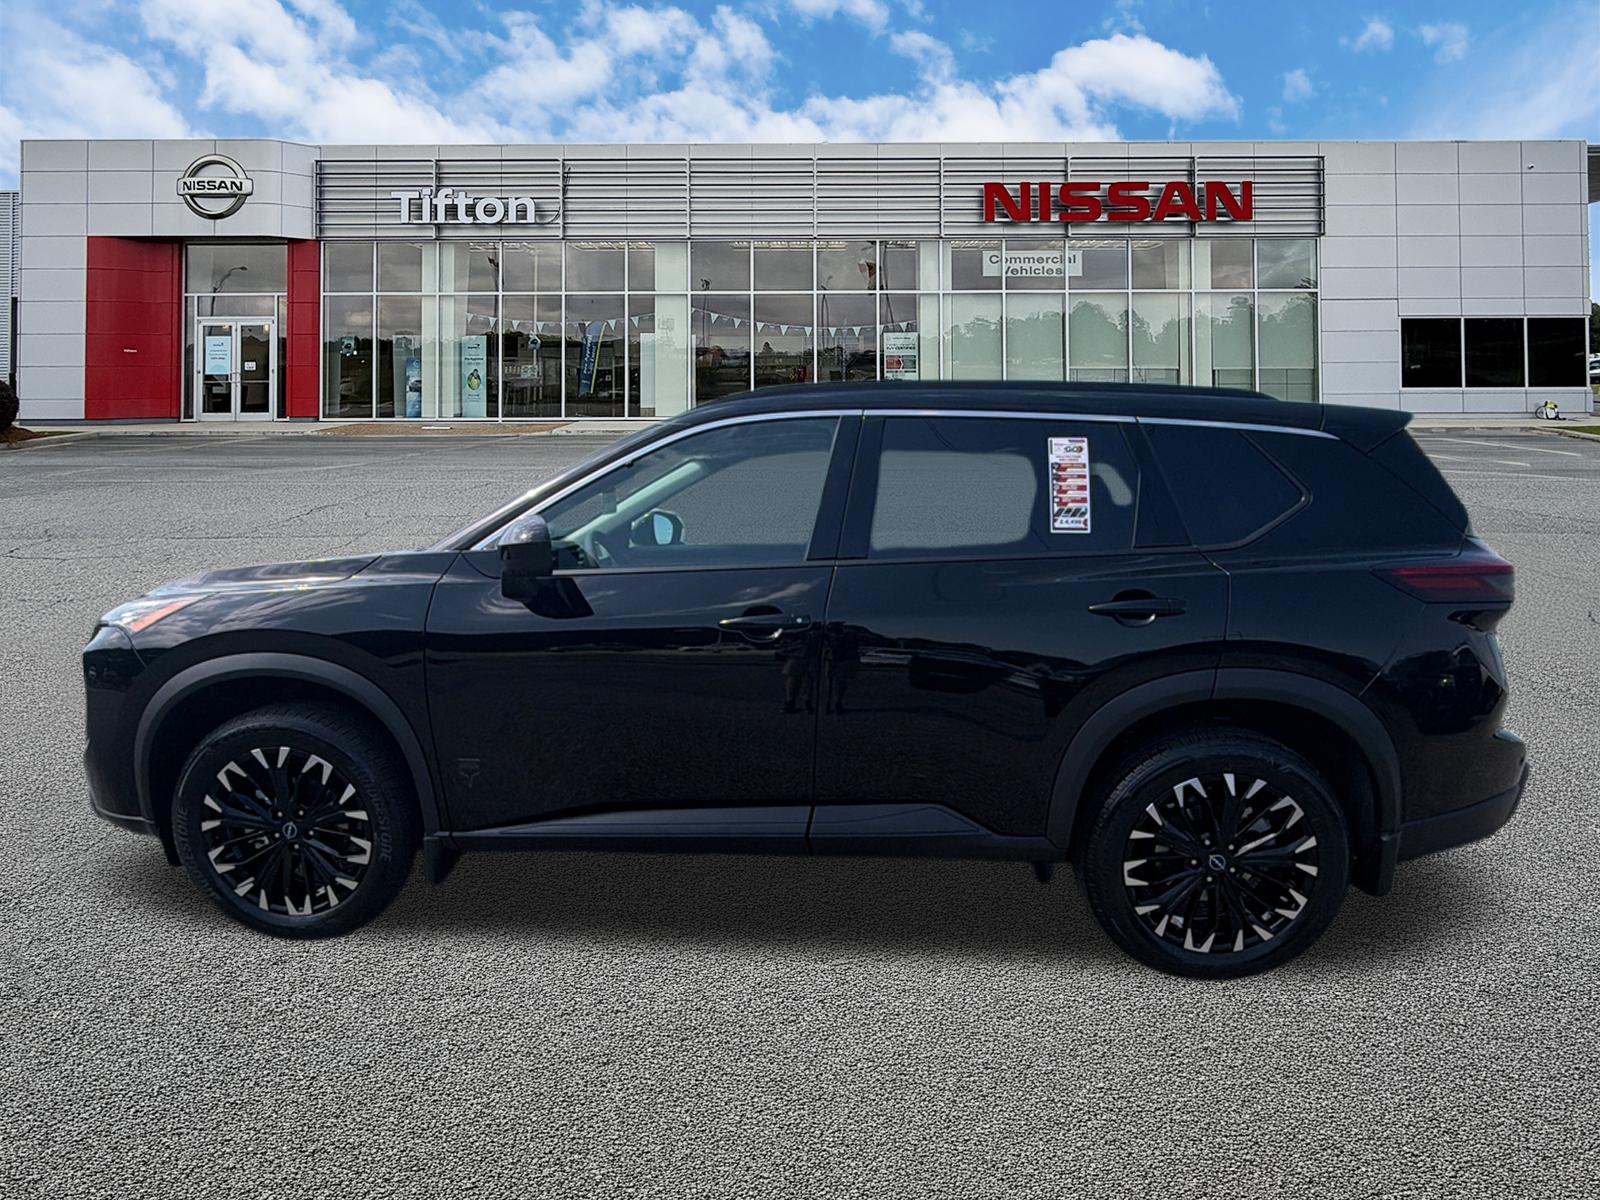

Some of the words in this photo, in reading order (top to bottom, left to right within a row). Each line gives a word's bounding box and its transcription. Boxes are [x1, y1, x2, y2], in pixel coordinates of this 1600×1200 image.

[182, 180, 243, 191] NISSAN
[984, 181, 1253, 222] NISSAN
[391, 188, 536, 223] Tifton
